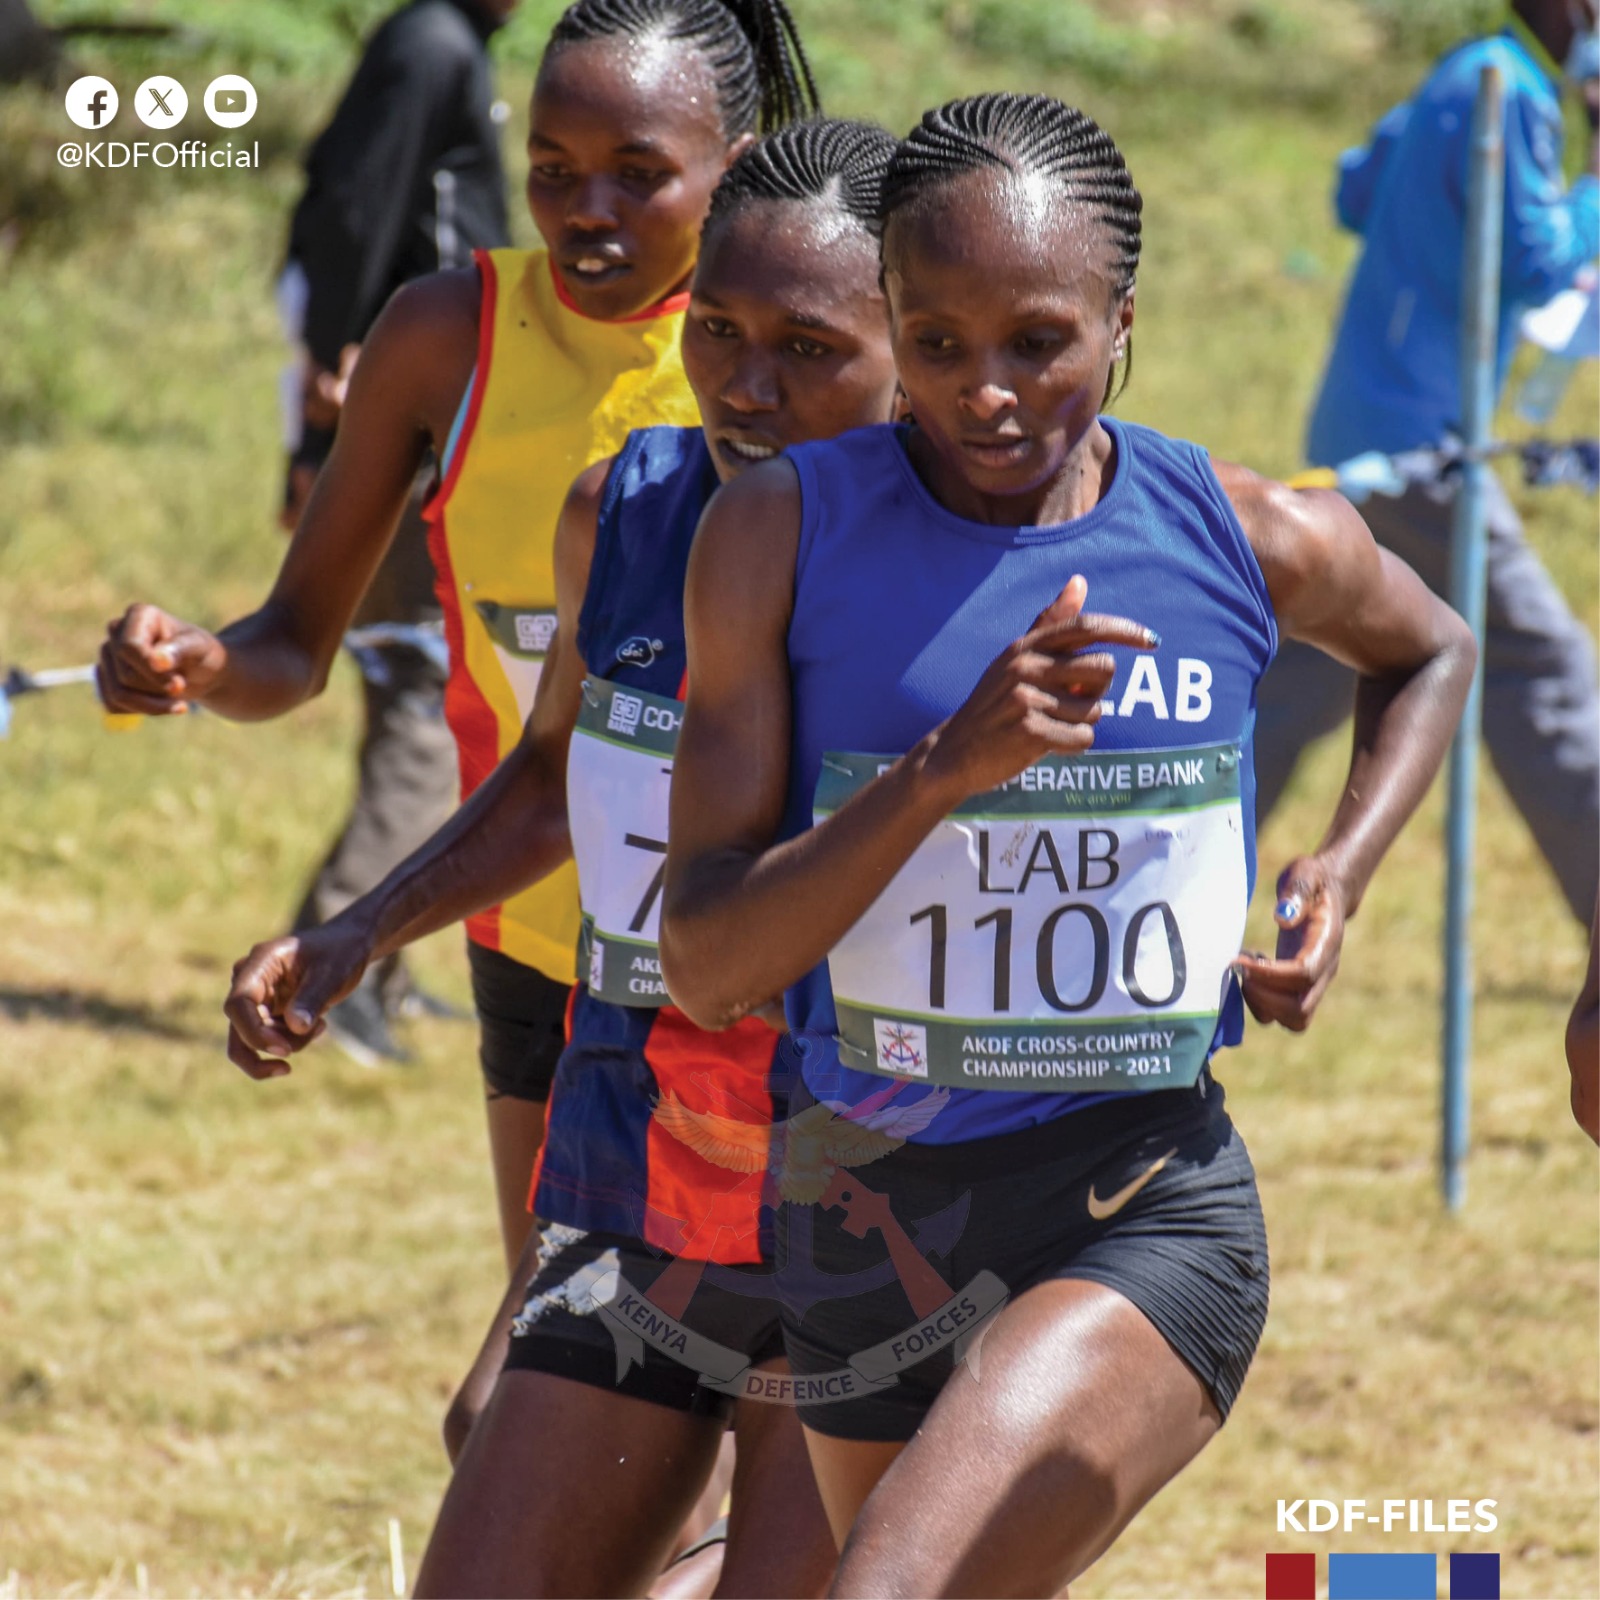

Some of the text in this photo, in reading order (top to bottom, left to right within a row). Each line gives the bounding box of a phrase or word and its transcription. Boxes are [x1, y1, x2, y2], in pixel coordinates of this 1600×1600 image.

[643, 706, 684, 731] CO-
[1137, 758, 1205, 789] BANK
[978, 829, 1120, 895] LAB
[909, 901, 1187, 1013] 1100
[962, 1031, 1175, 1055] AKDF CROSS-COUNTRY
[962, 1058, 1110, 1078] CHAMPIONSHIP
[1126, 1055, 1172, 1076] 2021
